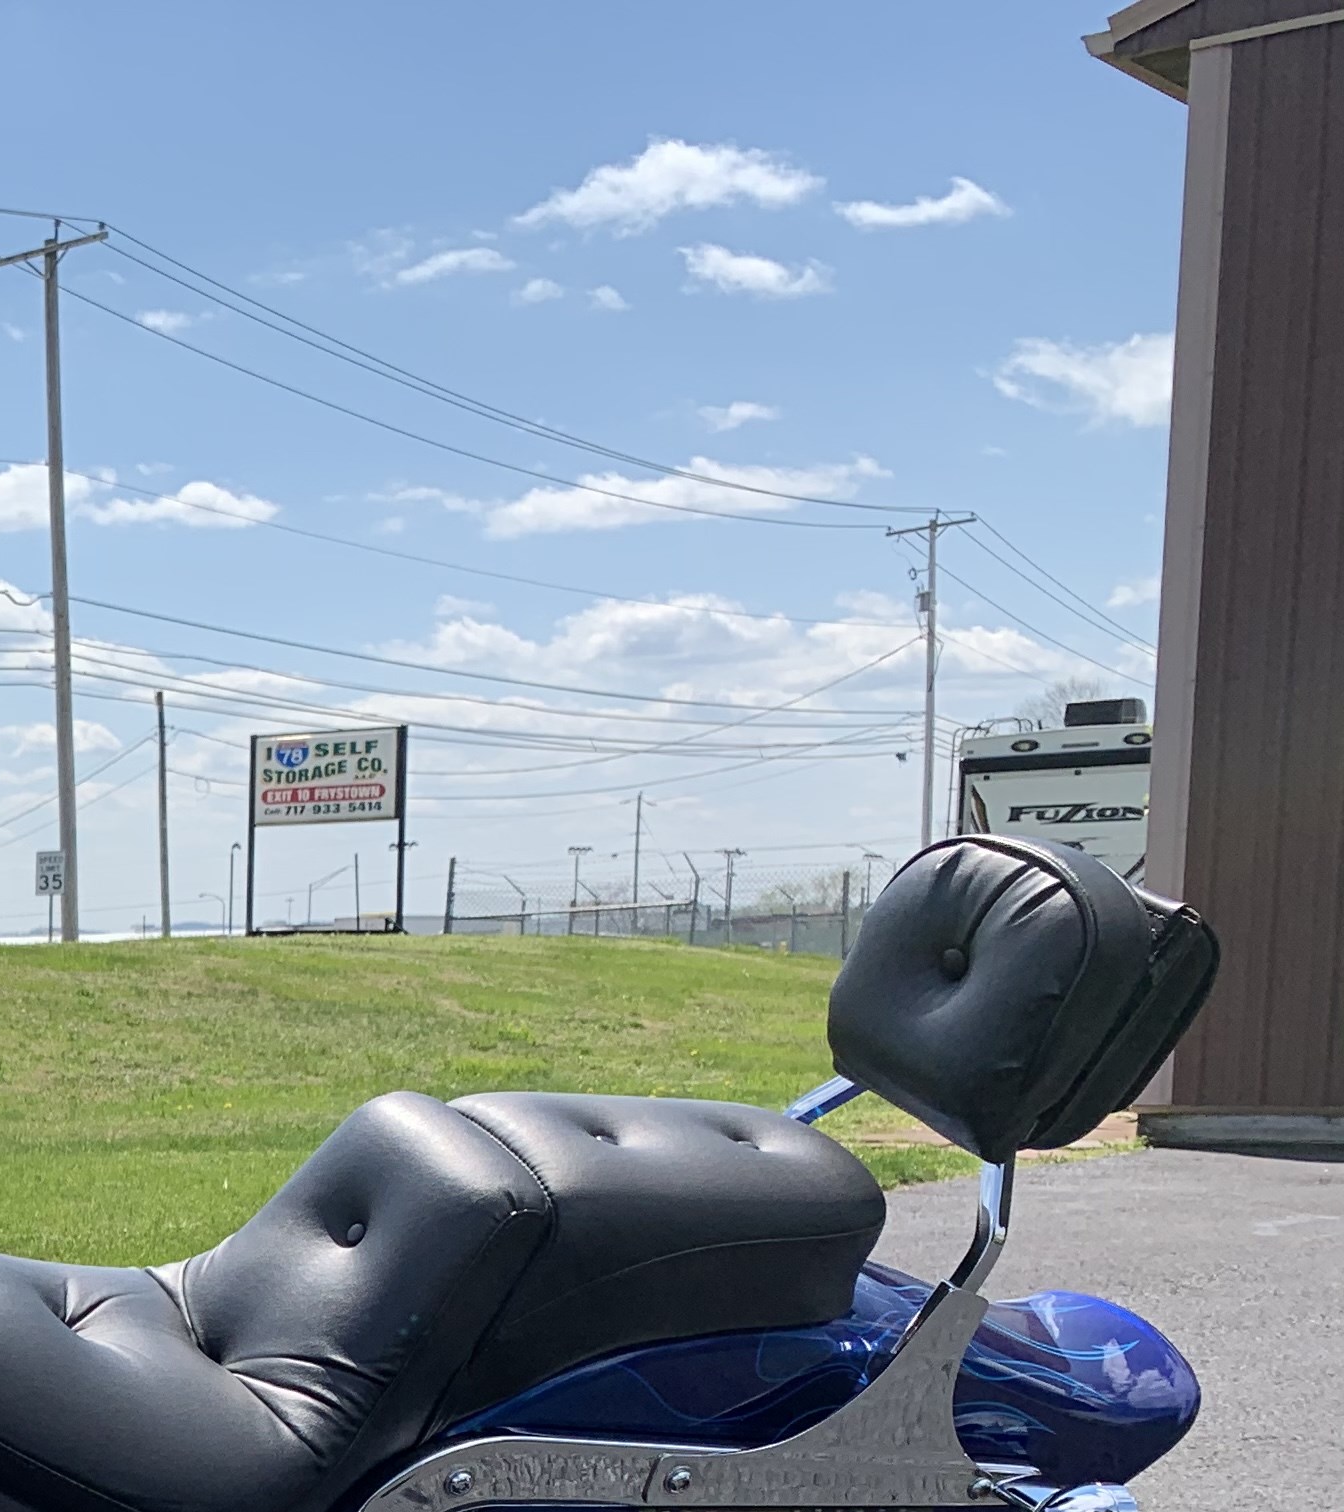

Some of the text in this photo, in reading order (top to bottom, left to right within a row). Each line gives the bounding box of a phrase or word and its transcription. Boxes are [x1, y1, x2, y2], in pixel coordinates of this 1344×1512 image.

[278, 748, 304, 765] 78
[314, 739, 379, 758] SELF
[262, 757, 388, 784] STORAGE CO.
[266, 784, 380, 803] EXIT 10 FRYSTOWN
[38, 855, 64, 865] SPEED
[39, 865, 61, 873] LIMIT
[38, 873, 63, 891] 35
